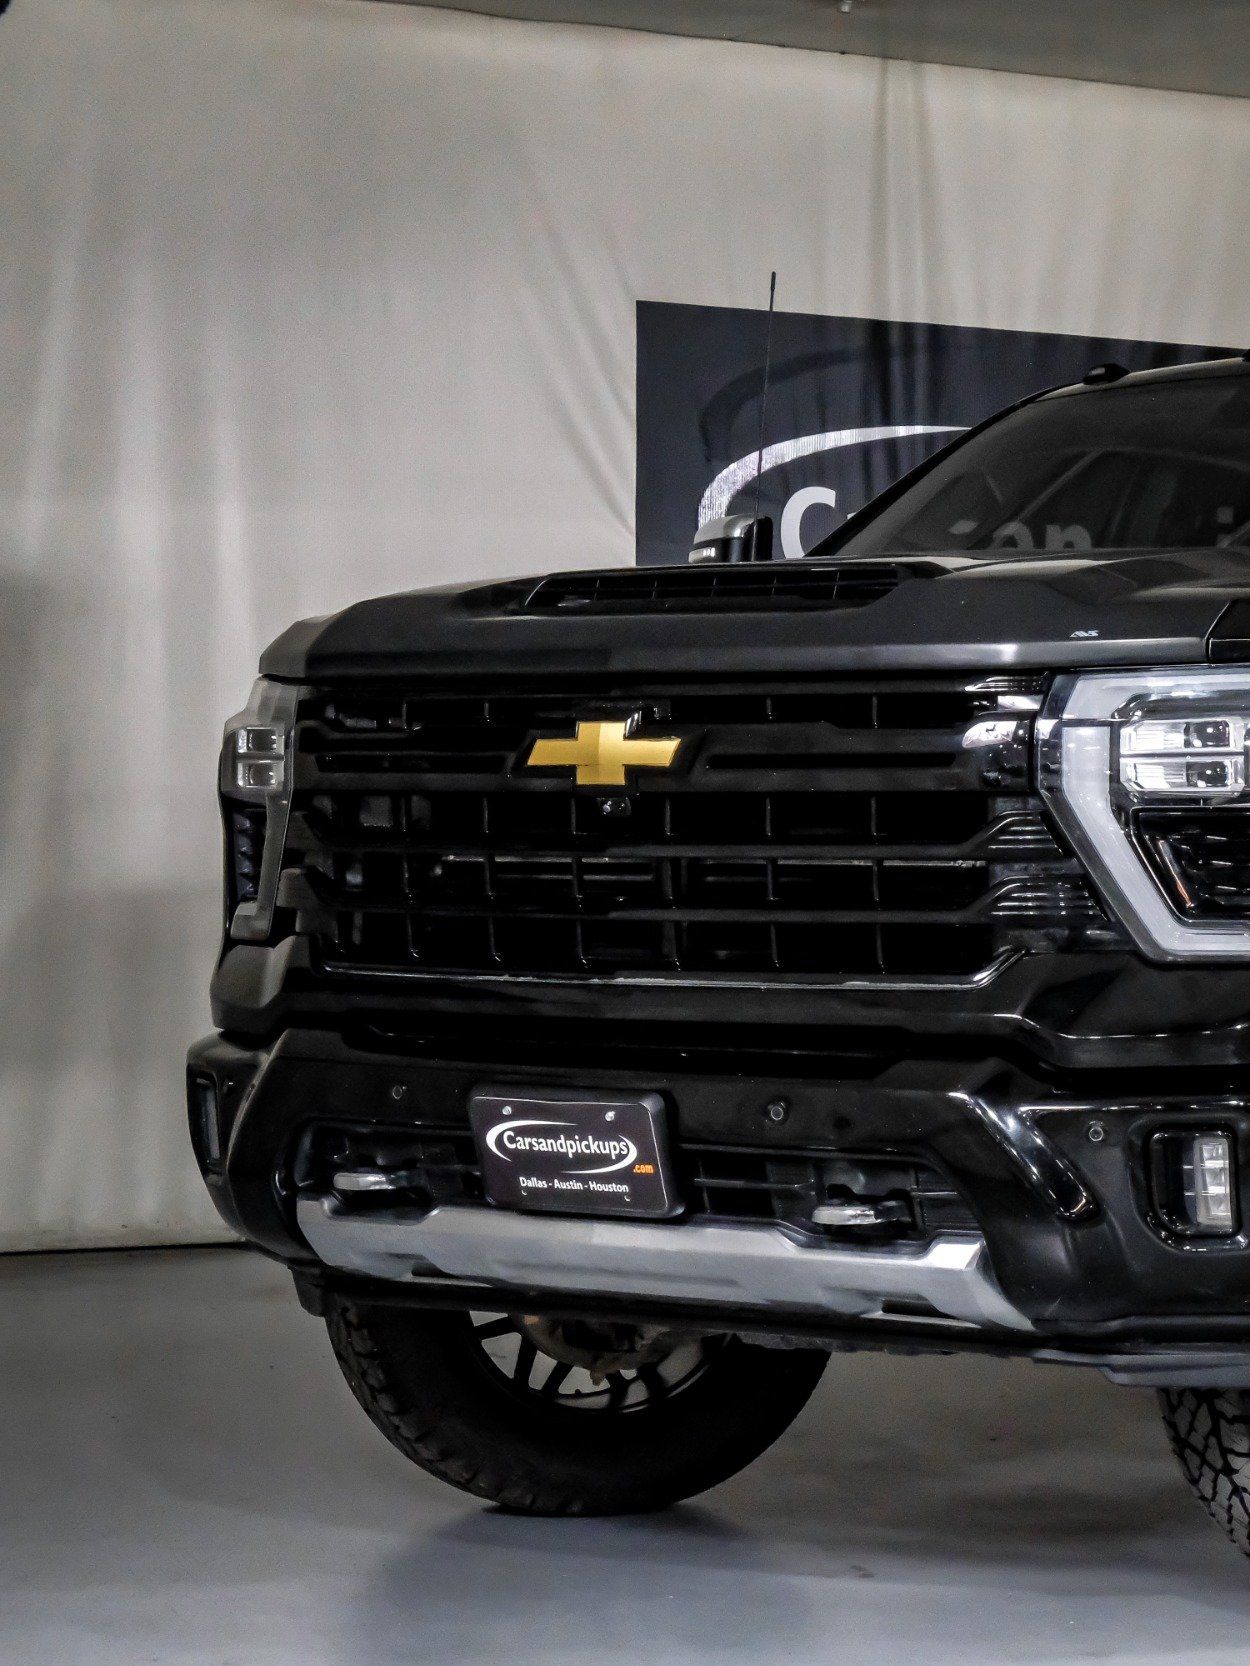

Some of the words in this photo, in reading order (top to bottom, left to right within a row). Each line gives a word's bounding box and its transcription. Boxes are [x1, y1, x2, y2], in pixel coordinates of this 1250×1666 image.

[502, 1130, 629, 1159] Carsandpickups
[633, 1163, 654, 1174] .com
[519, 1176, 547, 1189] Dallas
[554, 1178, 583, 1191] Austin
[589, 1181, 629, 1194] Houston
